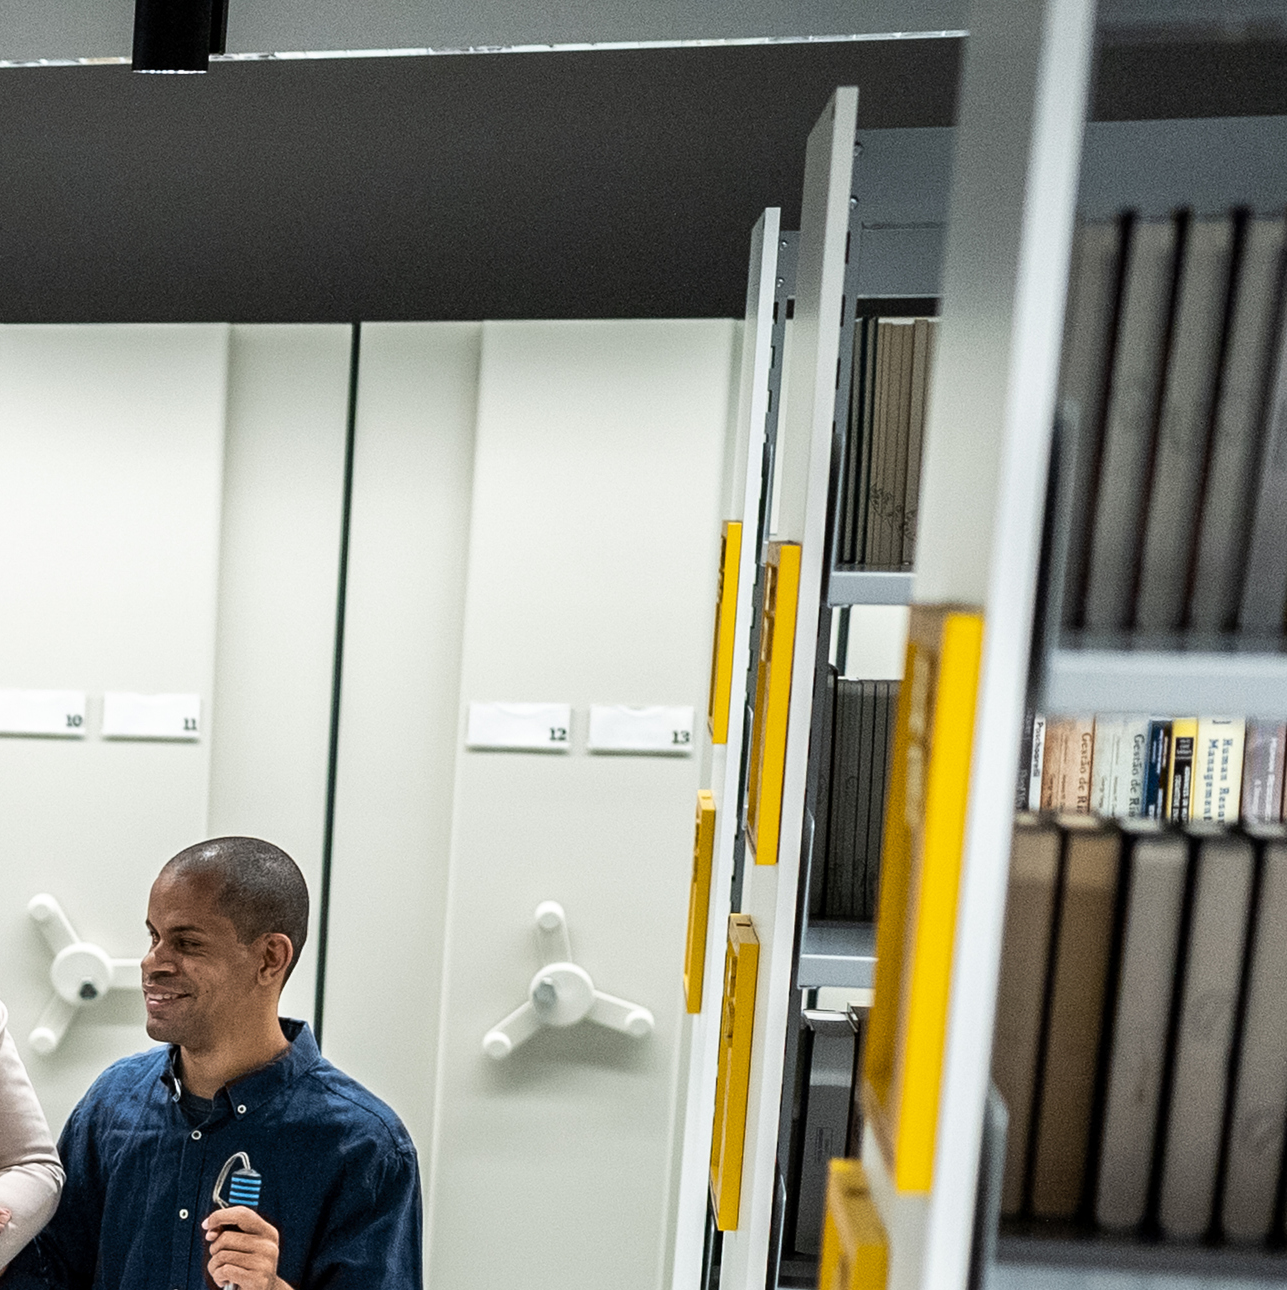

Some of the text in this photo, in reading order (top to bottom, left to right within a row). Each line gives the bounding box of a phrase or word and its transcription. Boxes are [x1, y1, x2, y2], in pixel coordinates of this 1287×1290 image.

[66, 714, 83, 727] 10
[183, 718, 197, 731] 11
[549, 727, 567, 741] 12
[672, 730, 690, 744] 13
